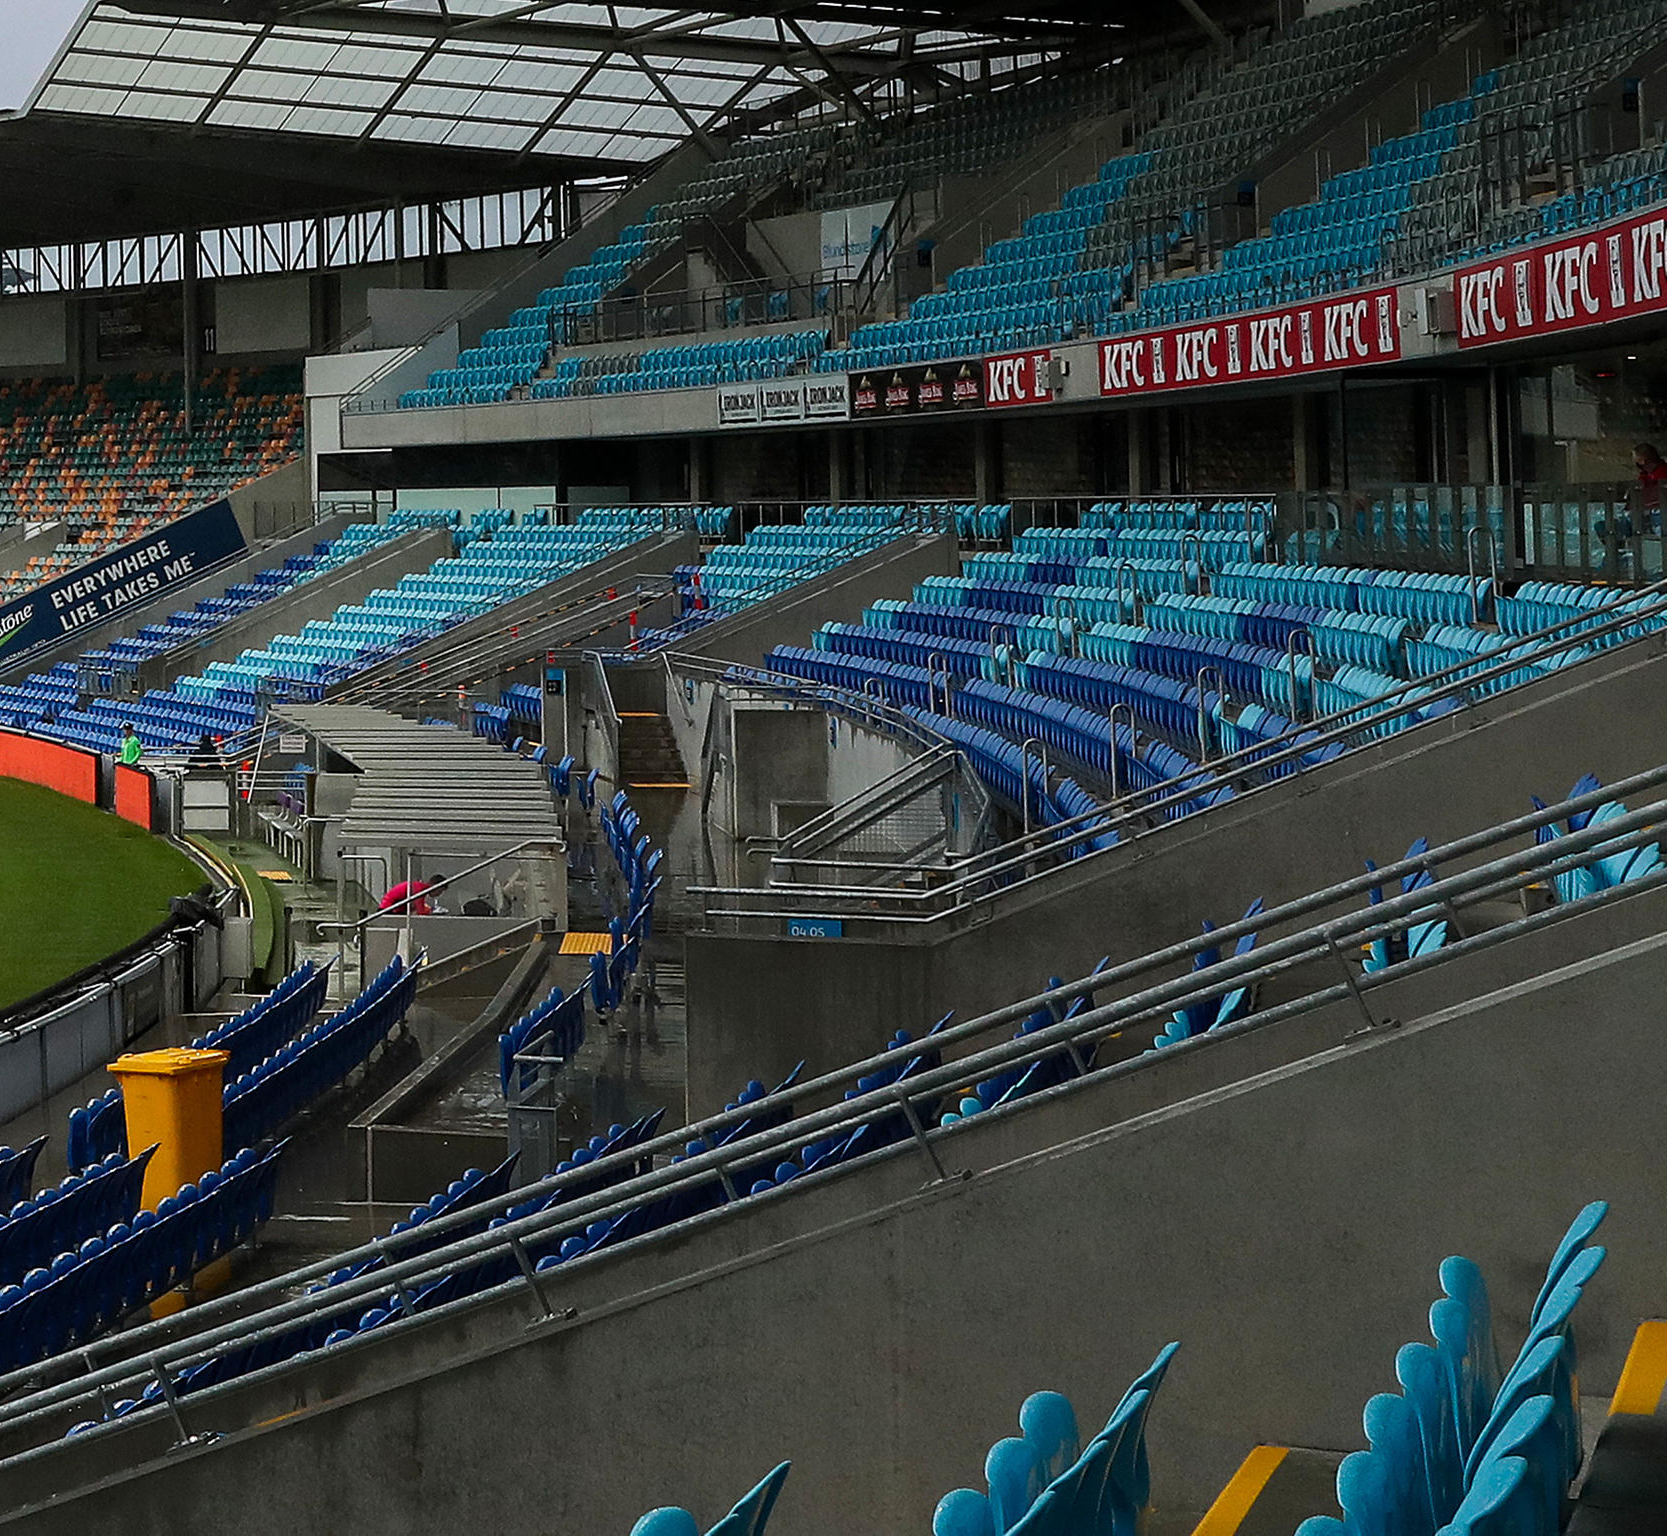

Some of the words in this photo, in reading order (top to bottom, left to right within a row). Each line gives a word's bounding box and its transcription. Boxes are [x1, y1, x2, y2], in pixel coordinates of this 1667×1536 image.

[1544, 241, 1600, 323] KFC
[1632, 219, 1667, 303] KF
[1324, 299, 1368, 362] KFC
[1460, 266, 1506, 339] KFC
[1103, 340, 1145, 390] KFC
[1175, 328, 1217, 382] KFC
[1250, 314, 1293, 372] KFC
[988, 356, 1026, 402] KFC
[50, 539, 170, 610] EVERYWHERE
[59, 602, 99, 632] LIFE
[101, 572, 160, 611] TAKES
